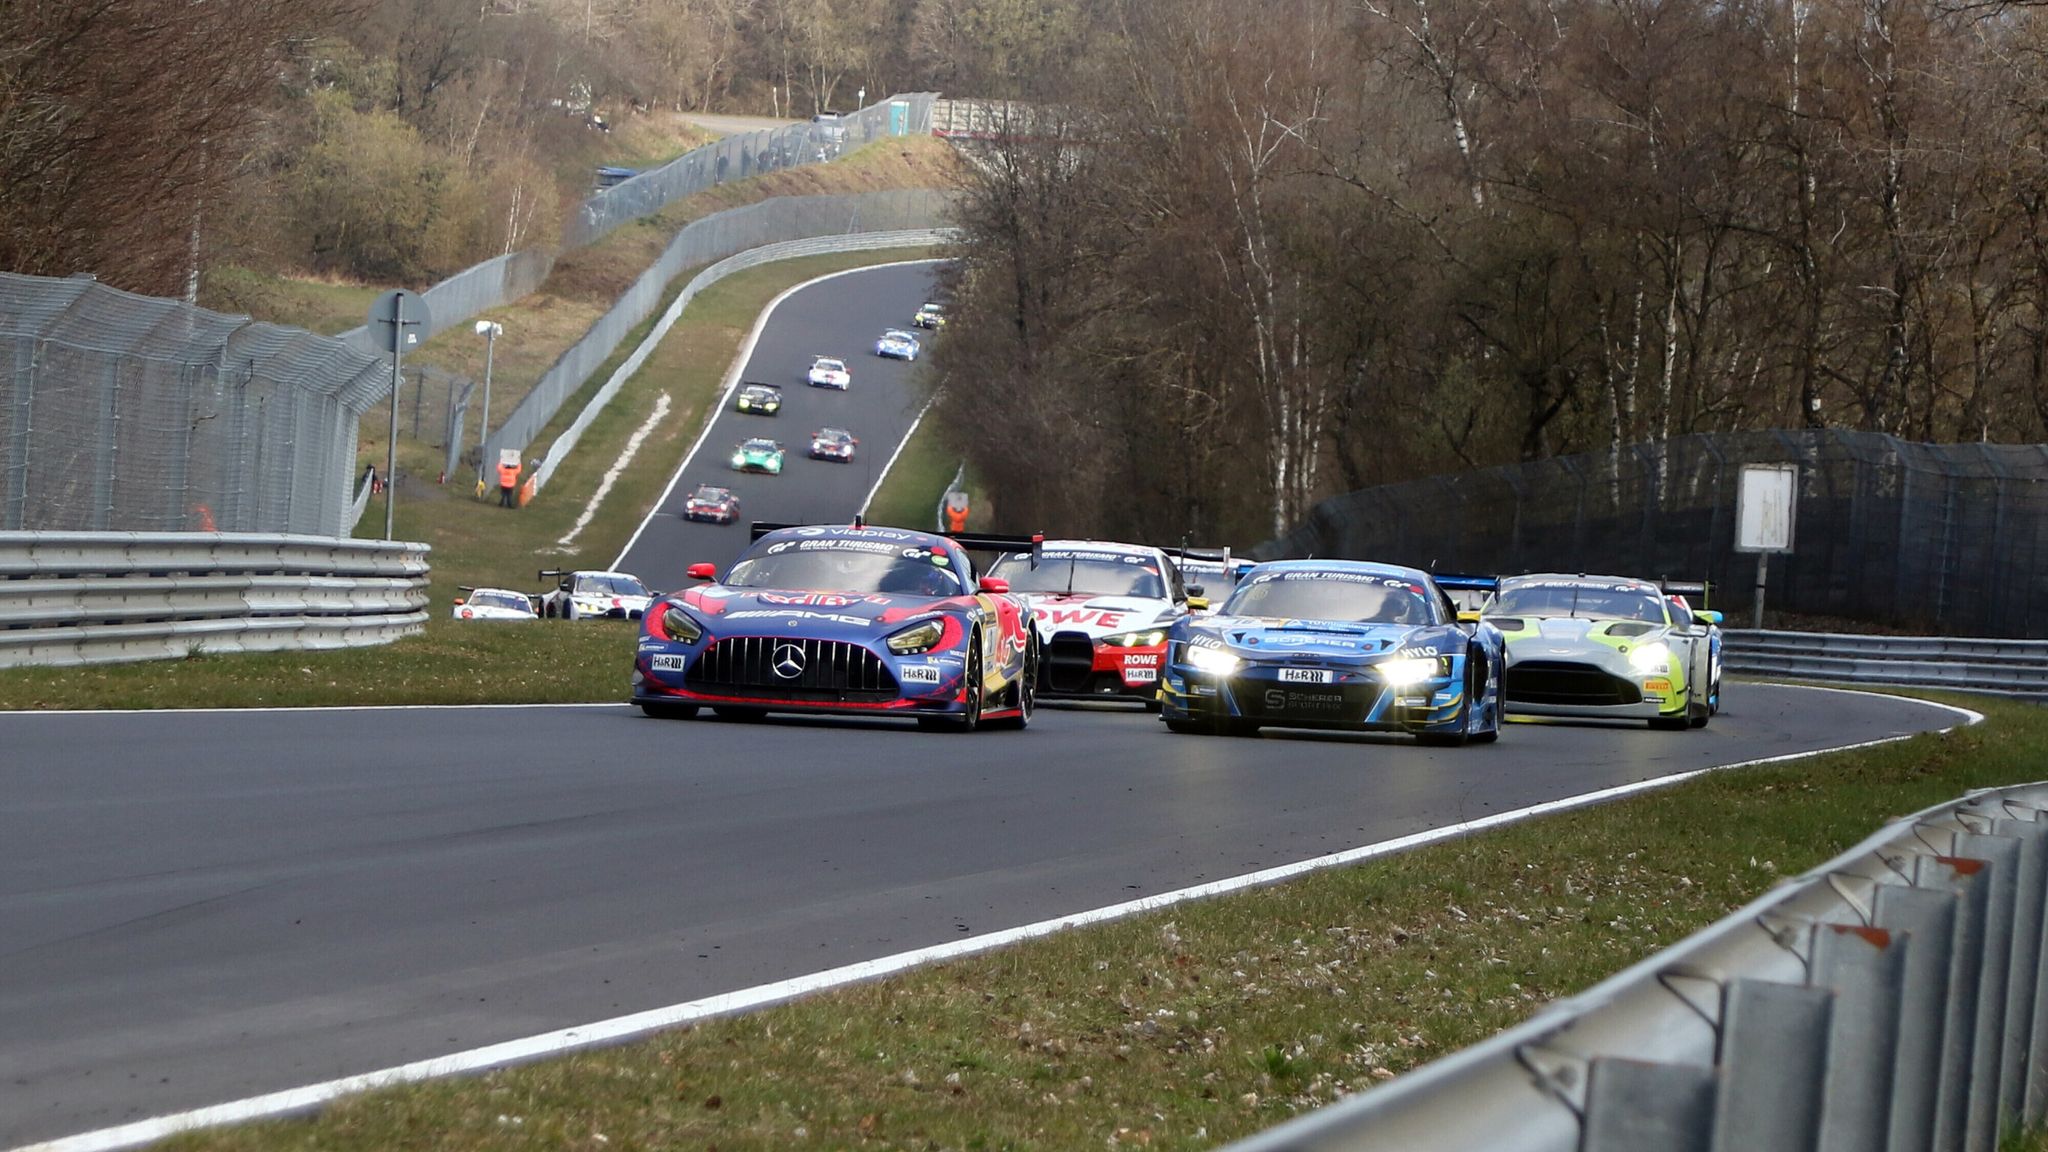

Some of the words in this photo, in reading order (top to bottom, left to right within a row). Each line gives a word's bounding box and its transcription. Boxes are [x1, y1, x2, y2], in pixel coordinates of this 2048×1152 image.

[831, 528, 911, 540] viaplay
[800, 540, 836, 548] GRAN
[838, 540, 893, 551] TURISMO
[1284, 572, 1319, 580] GRAN
[1321, 572, 1375, 582] TURISMO
[768, 610, 871, 626] AMG
[1031, 608, 1125, 628] OWE
[1191, 634, 1222, 649] HYLO
[1124, 655, 1158, 665] ROWE
